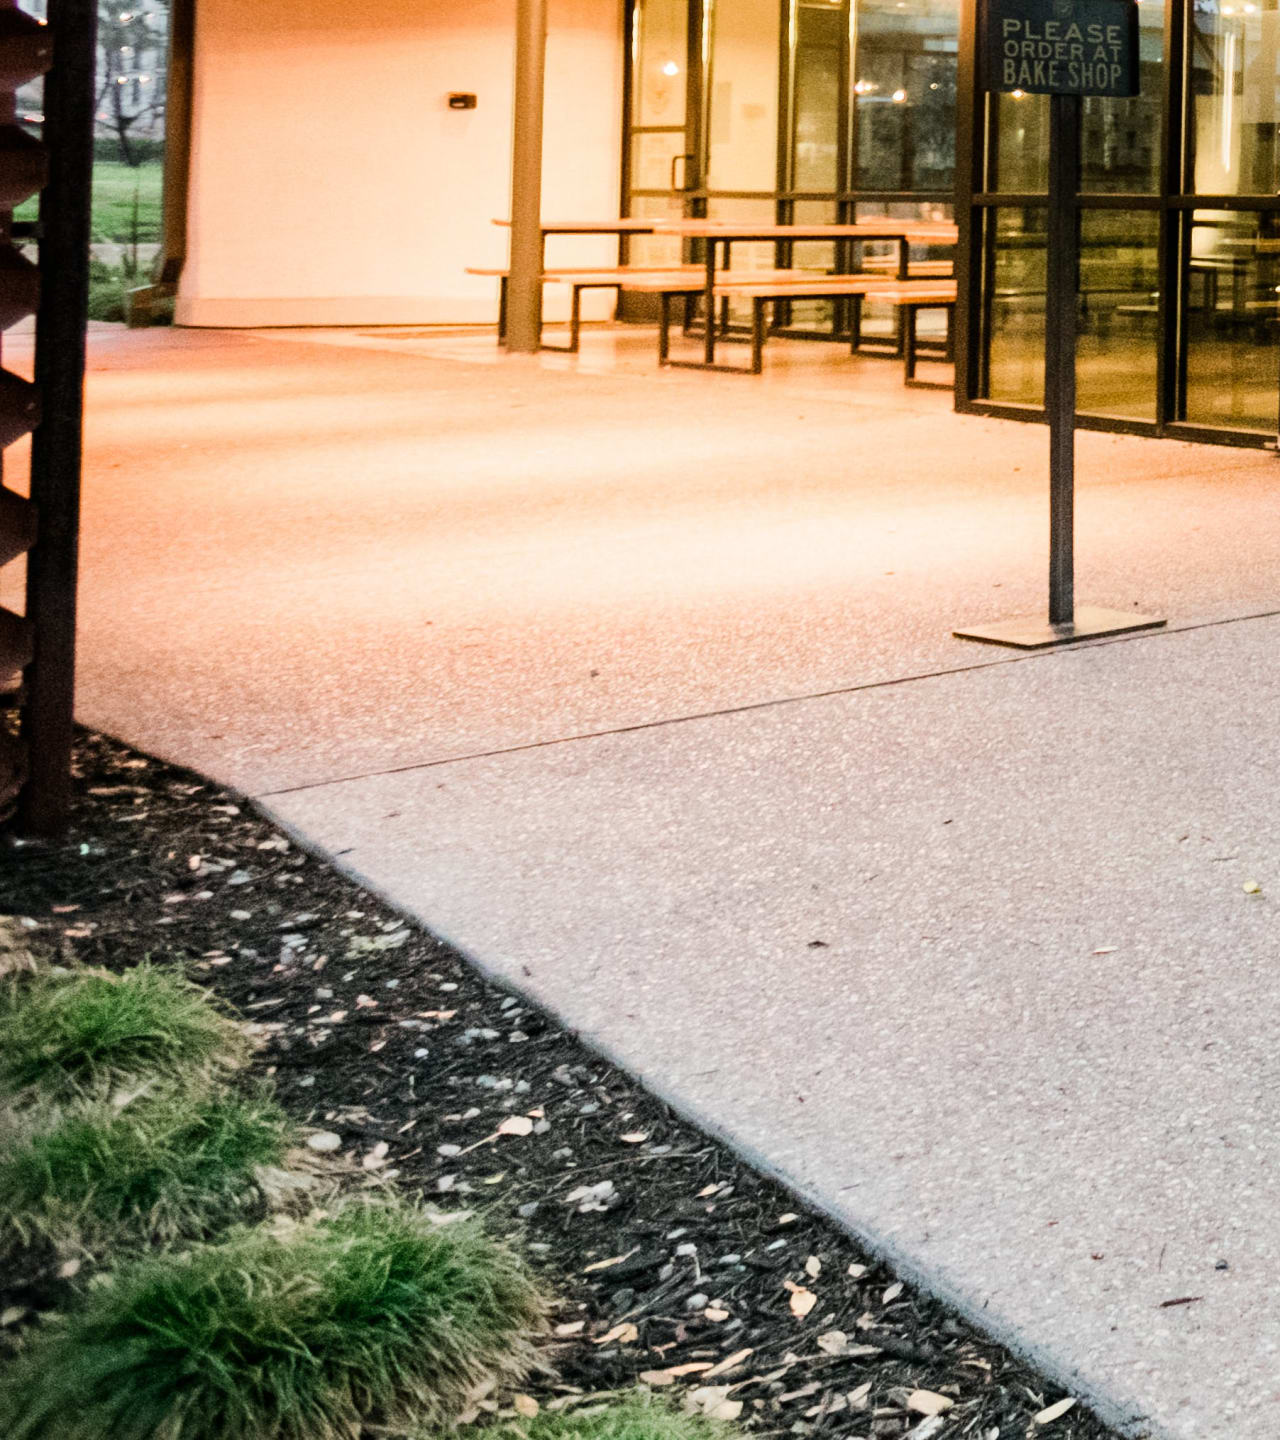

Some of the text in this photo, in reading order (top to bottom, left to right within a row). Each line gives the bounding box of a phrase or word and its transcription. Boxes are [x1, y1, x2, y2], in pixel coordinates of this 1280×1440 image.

[1002, 18, 1122, 45] PLEASE
[1003, 40, 1122, 63] ORDER AT
[1003, 59, 1122, 89] BAKE SHOP
